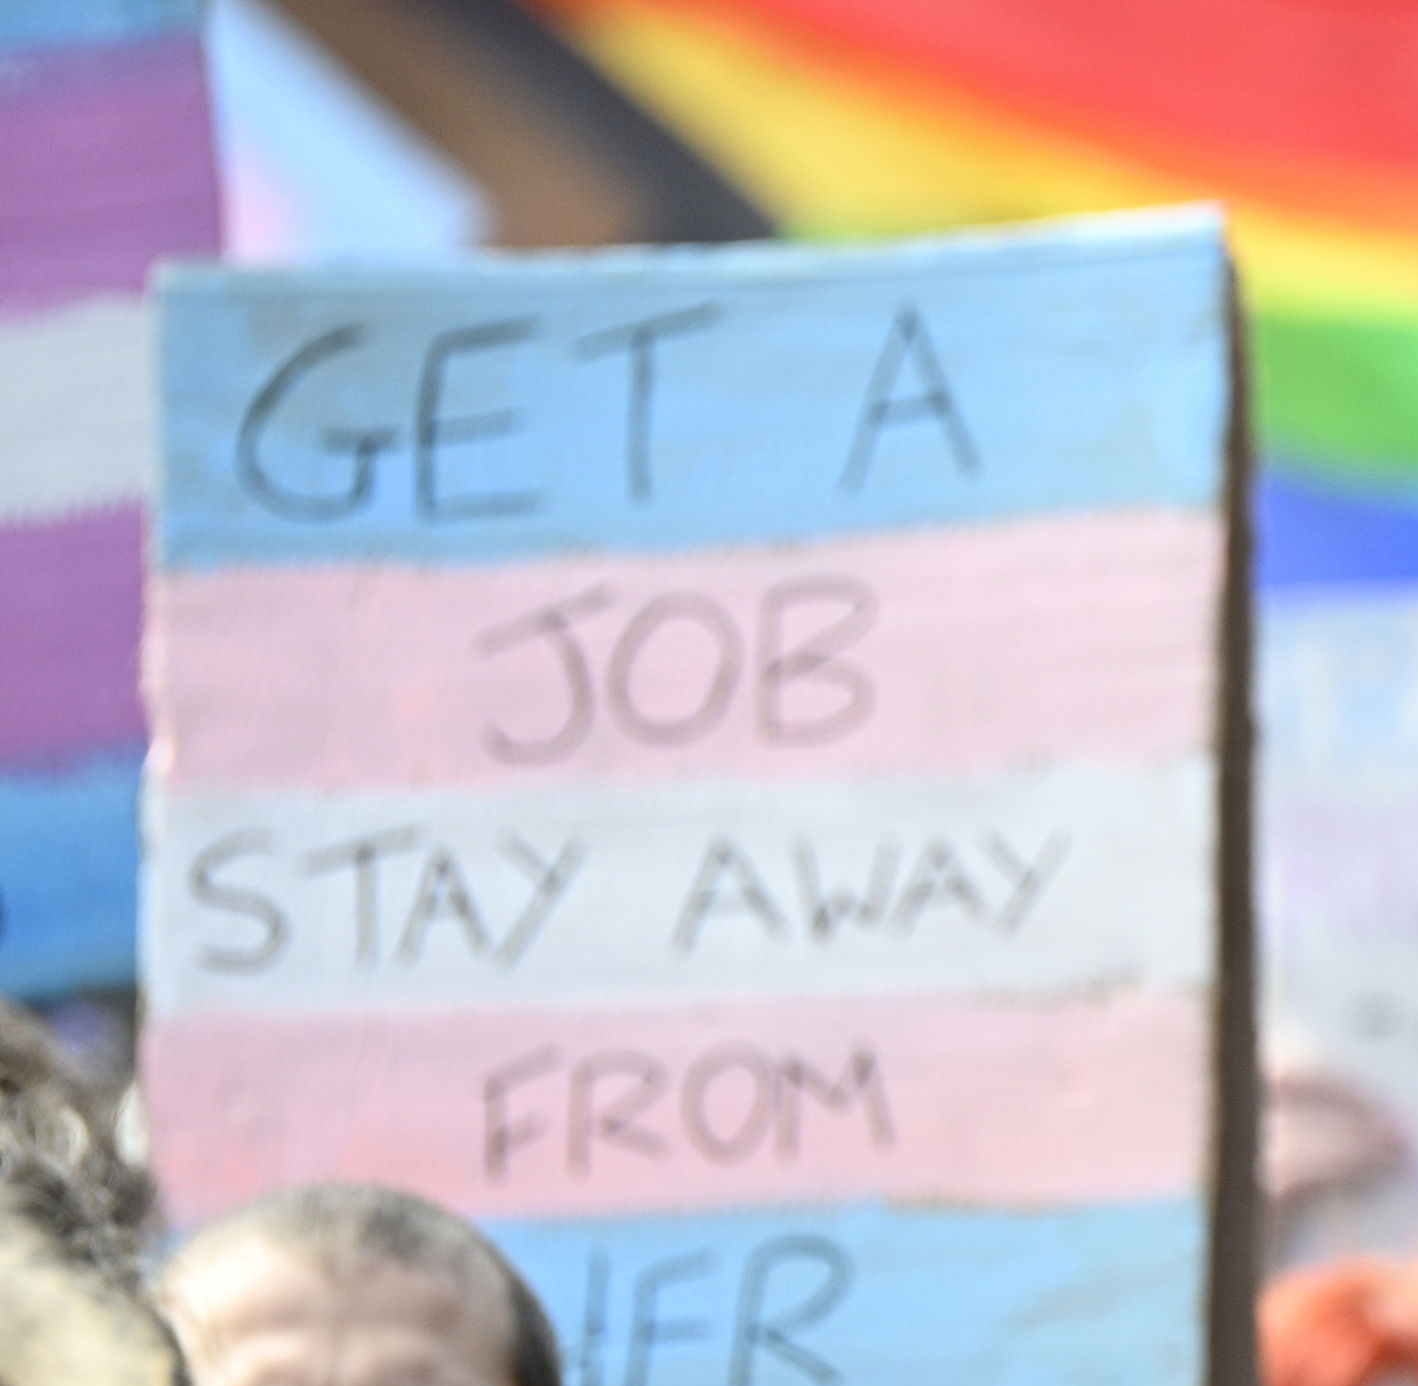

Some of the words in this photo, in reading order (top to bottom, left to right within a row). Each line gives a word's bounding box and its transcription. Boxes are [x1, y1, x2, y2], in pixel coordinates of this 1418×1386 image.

[236, 302, 727, 526] GET
[837, 303, 983, 498] A
[475, 574, 880, 769] JOB
[189, 826, 588, 975] STAY
[672, 830, 1074, 956] AWAY
[479, 1040, 897, 1185] FROM
